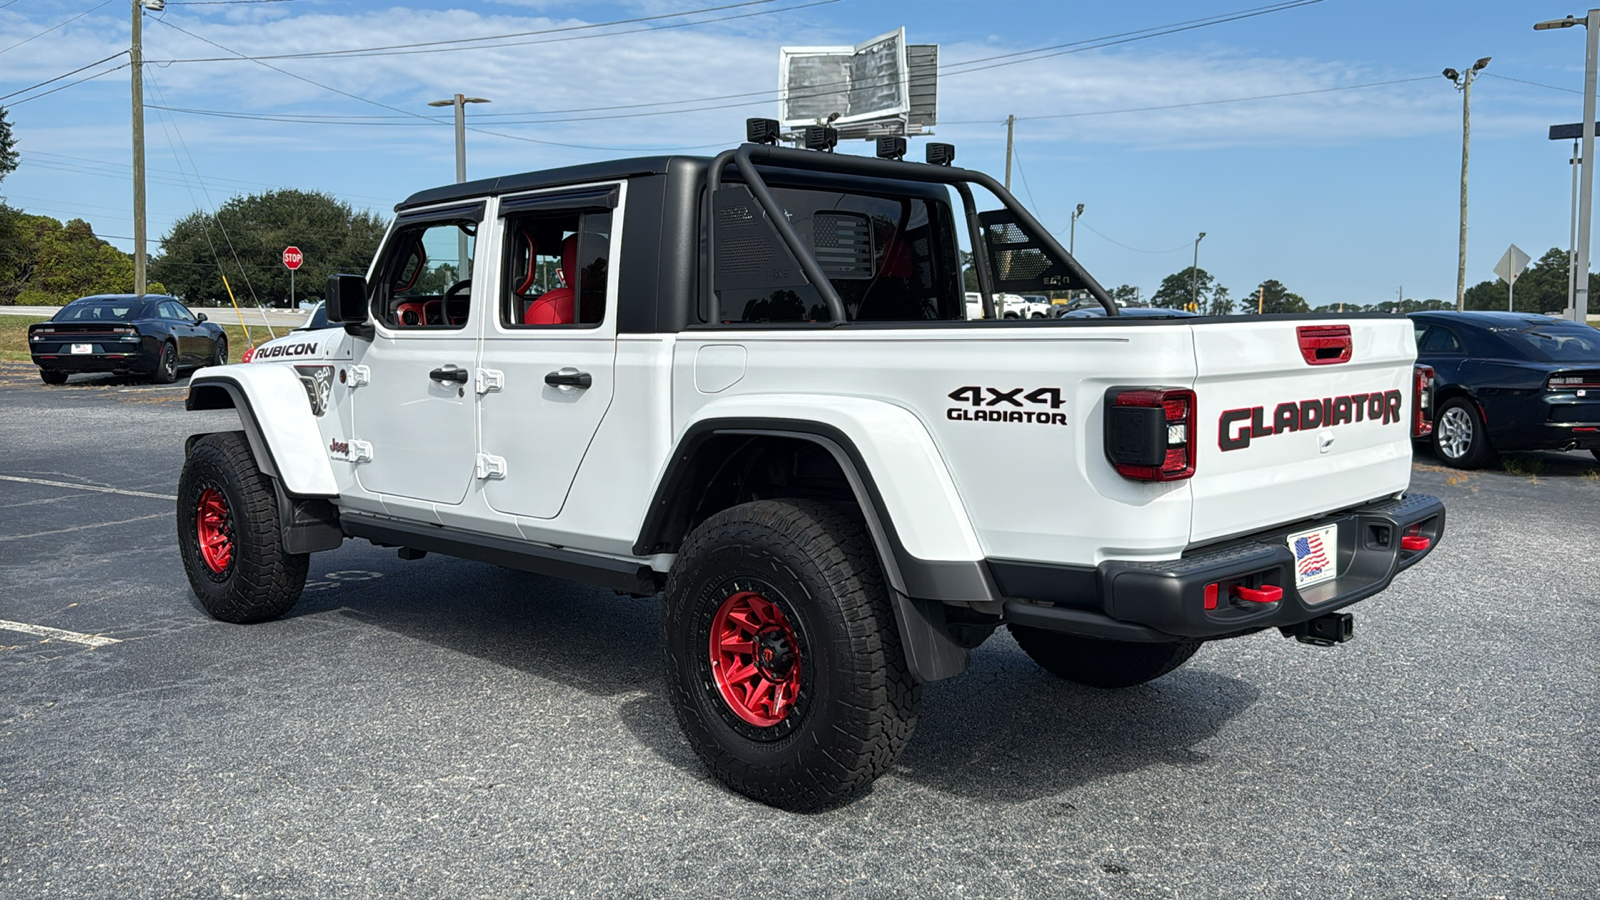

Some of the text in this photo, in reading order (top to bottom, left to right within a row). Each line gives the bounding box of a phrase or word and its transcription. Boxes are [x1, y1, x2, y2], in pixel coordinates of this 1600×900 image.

[284, 253, 302, 263] STOP
[254, 342, 318, 360] RUBICON
[947, 408, 1068, 425] GLADIATOR
[1218, 389, 1402, 453] GLADIATOR
[329, 437, 350, 457] Jeep
